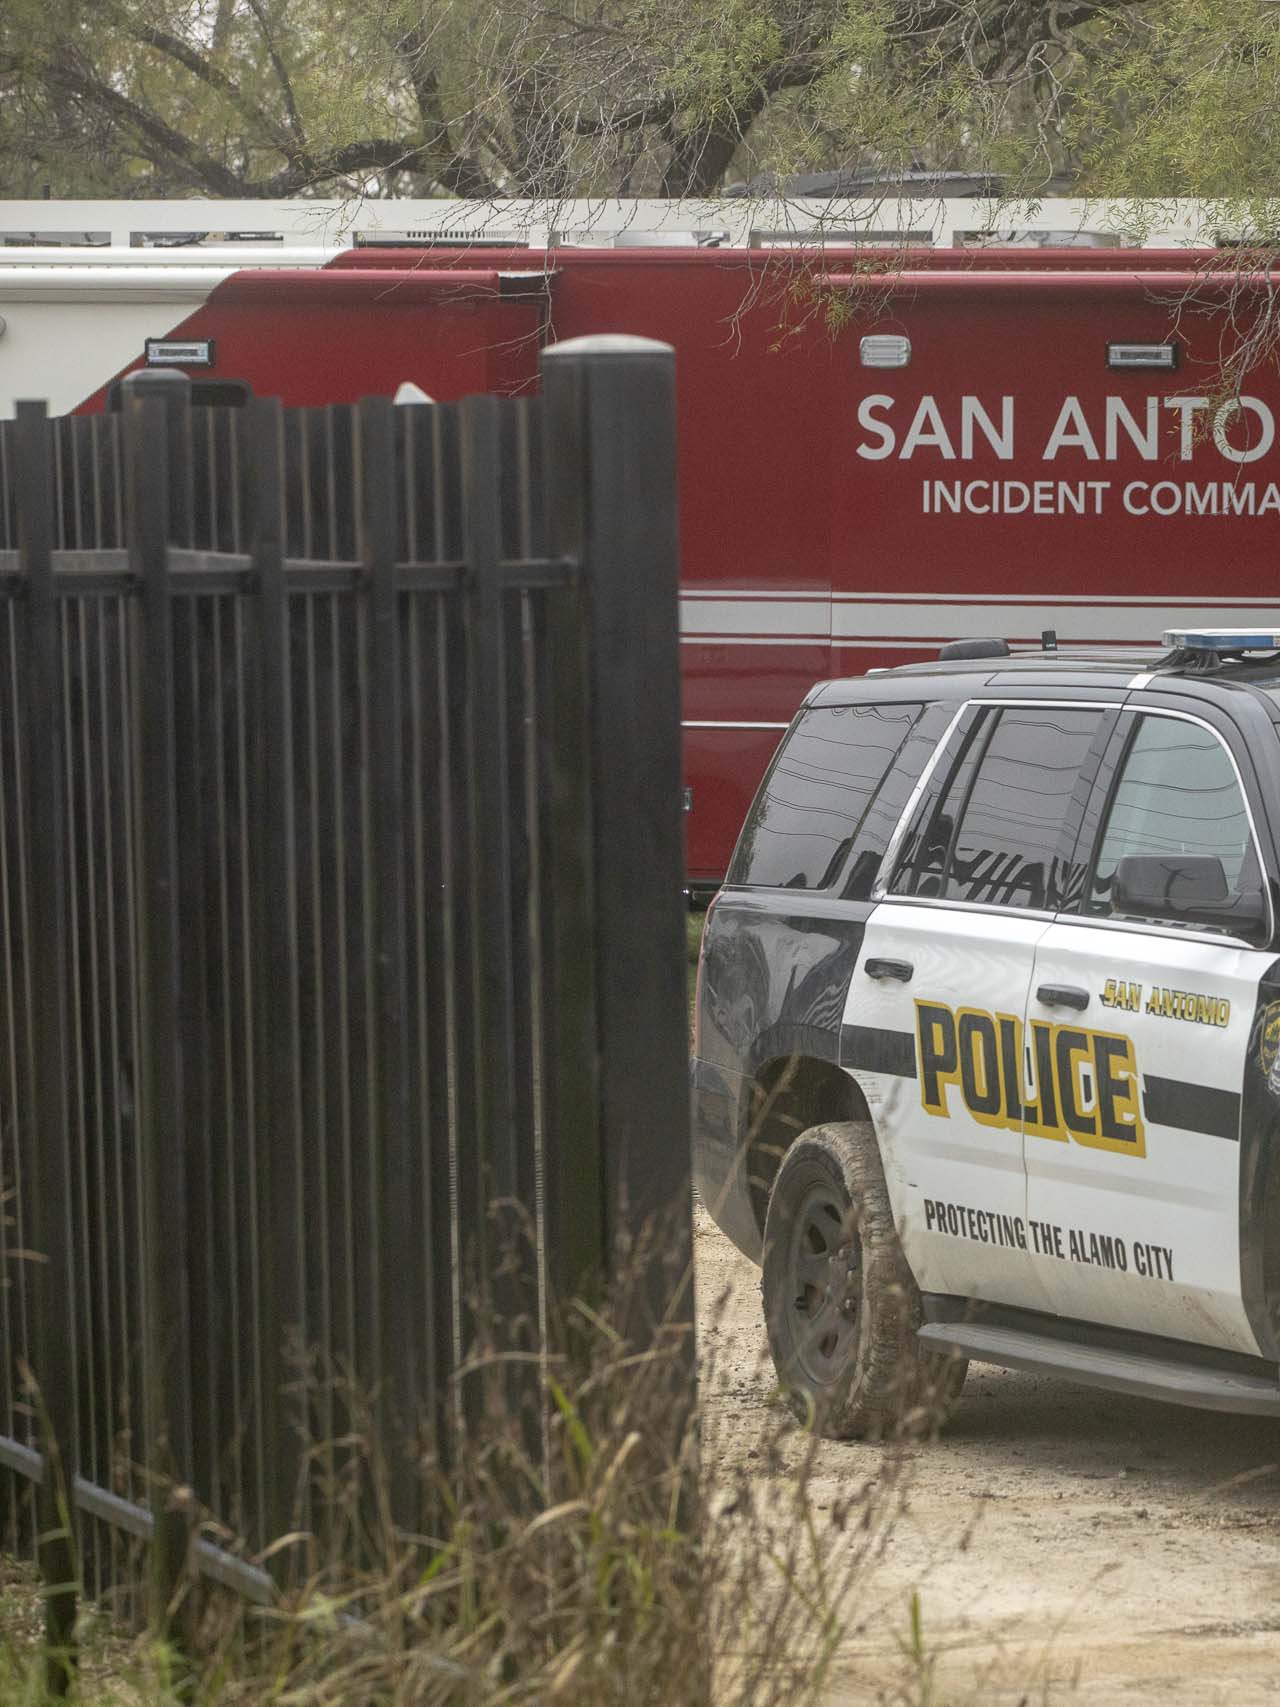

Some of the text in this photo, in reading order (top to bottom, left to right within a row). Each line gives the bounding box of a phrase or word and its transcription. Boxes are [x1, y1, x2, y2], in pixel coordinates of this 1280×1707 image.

[855, 393, 1014, 461] SAN
[922, 480, 1110, 515] INCIDENT
[1099, 978, 1231, 1028] SAN ANTONIO
[913, 999, 1147, 1158] POLICE
[924, 1199, 1175, 1281] PROTECTING THE ALAMO CITY
